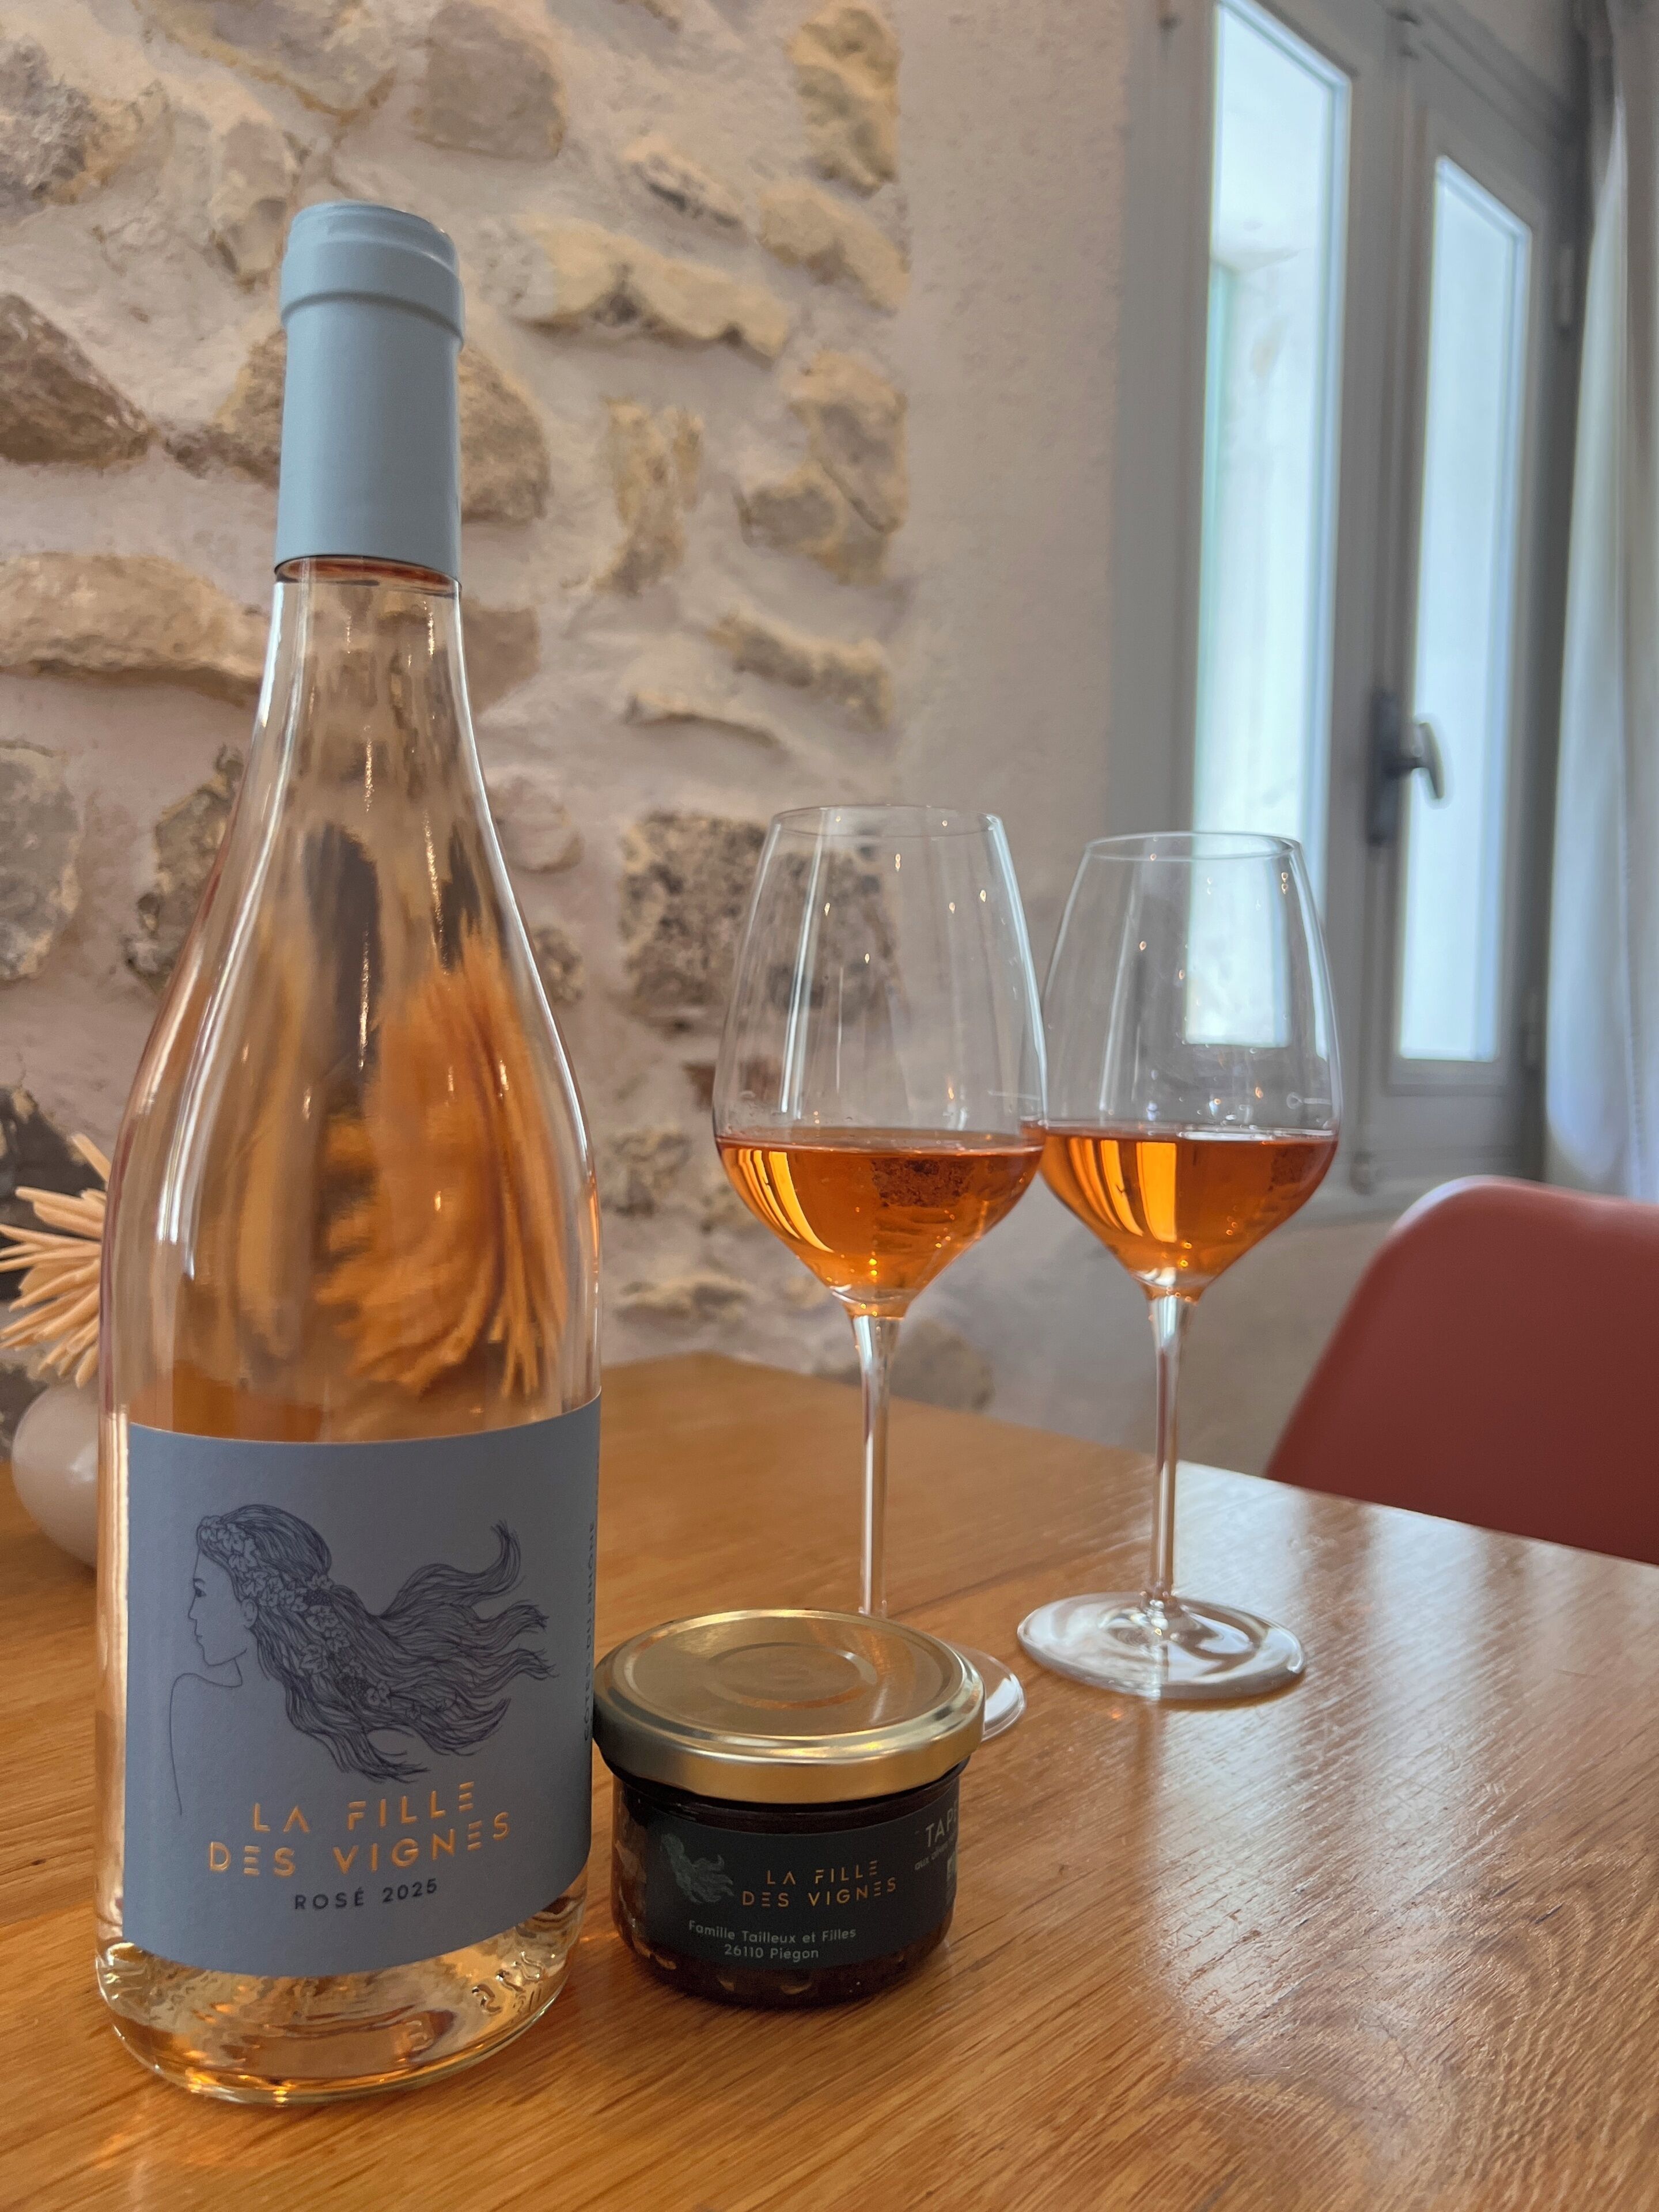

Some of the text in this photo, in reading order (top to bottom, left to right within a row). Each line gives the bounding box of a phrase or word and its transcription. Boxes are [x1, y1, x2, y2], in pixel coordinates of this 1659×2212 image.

[252, 1781, 475, 1834] LA FILLE
[209, 1811, 510, 1877] DES VIGNES
[767, 1859, 878, 1885] LA FILLE
[294, 1877, 438, 1910] ROSÉ 2025
[742, 1876, 897, 1908] DES VIGNES
[688, 1919, 857, 1944] Famille Tailleux et Filles
[724, 1943, 764, 1959] 26110
